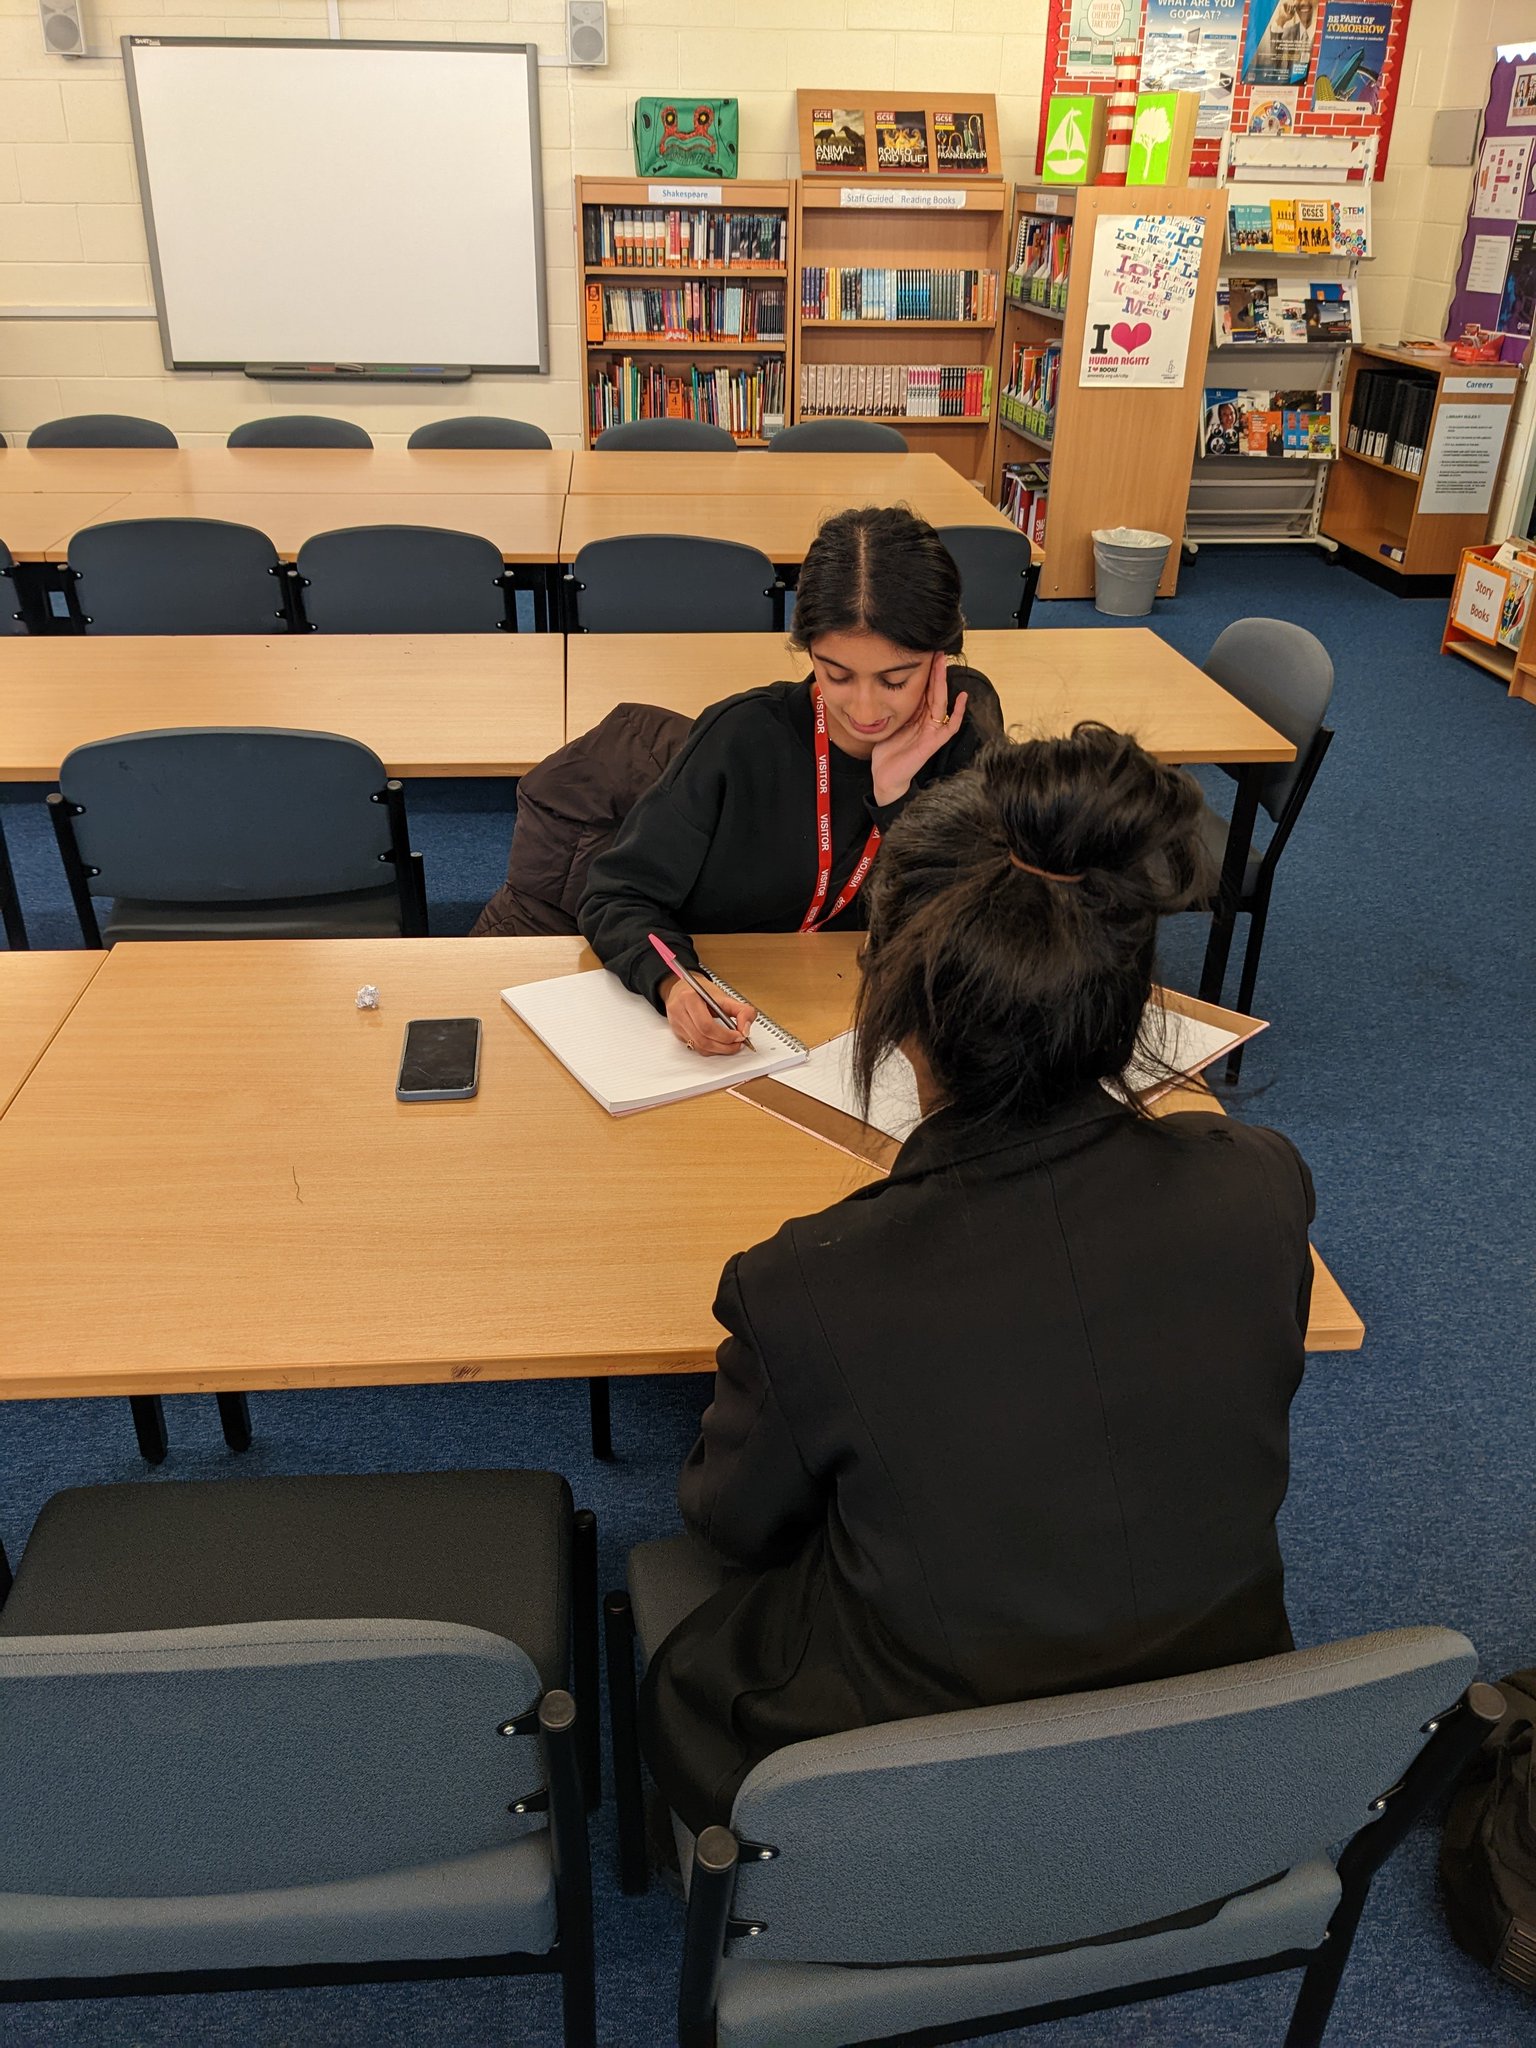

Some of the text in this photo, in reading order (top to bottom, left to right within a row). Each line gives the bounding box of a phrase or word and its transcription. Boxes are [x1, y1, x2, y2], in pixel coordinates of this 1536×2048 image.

[1170, 9, 1221, 20] GOOD AT?
[1340, 15, 1362, 23] PART
[1363, 16, 1375, 24] OF
[1327, 24, 1386, 34] TOMORROW
[816, 145, 854, 154] ANIMAL
[878, 147, 912, 155] ROMEO
[816, 152, 843, 161] FARM
[900, 154, 927, 162] JULIET
[662, 189, 708, 199] Shakespeare
[847, 194, 955, 205] Staff Guided Reading Books
[591, 304, 598, 314] 2
[1090, 324, 1110, 354] I
[1088, 356, 1150, 365] HUMAN RIGHTS
[1466, 381, 1493, 389] Careers
[672, 396, 677, 406] 4
[1476, 581, 1494, 600] Story
[1471, 604, 1490, 623] Books
[816, 694, 826, 734] VISITOR
[818, 754, 827, 794] VISITOR
[820, 814, 830, 852] VISITOR
[849, 856, 871, 889] VISITOR
[817, 869, 829, 897] VISITOR
